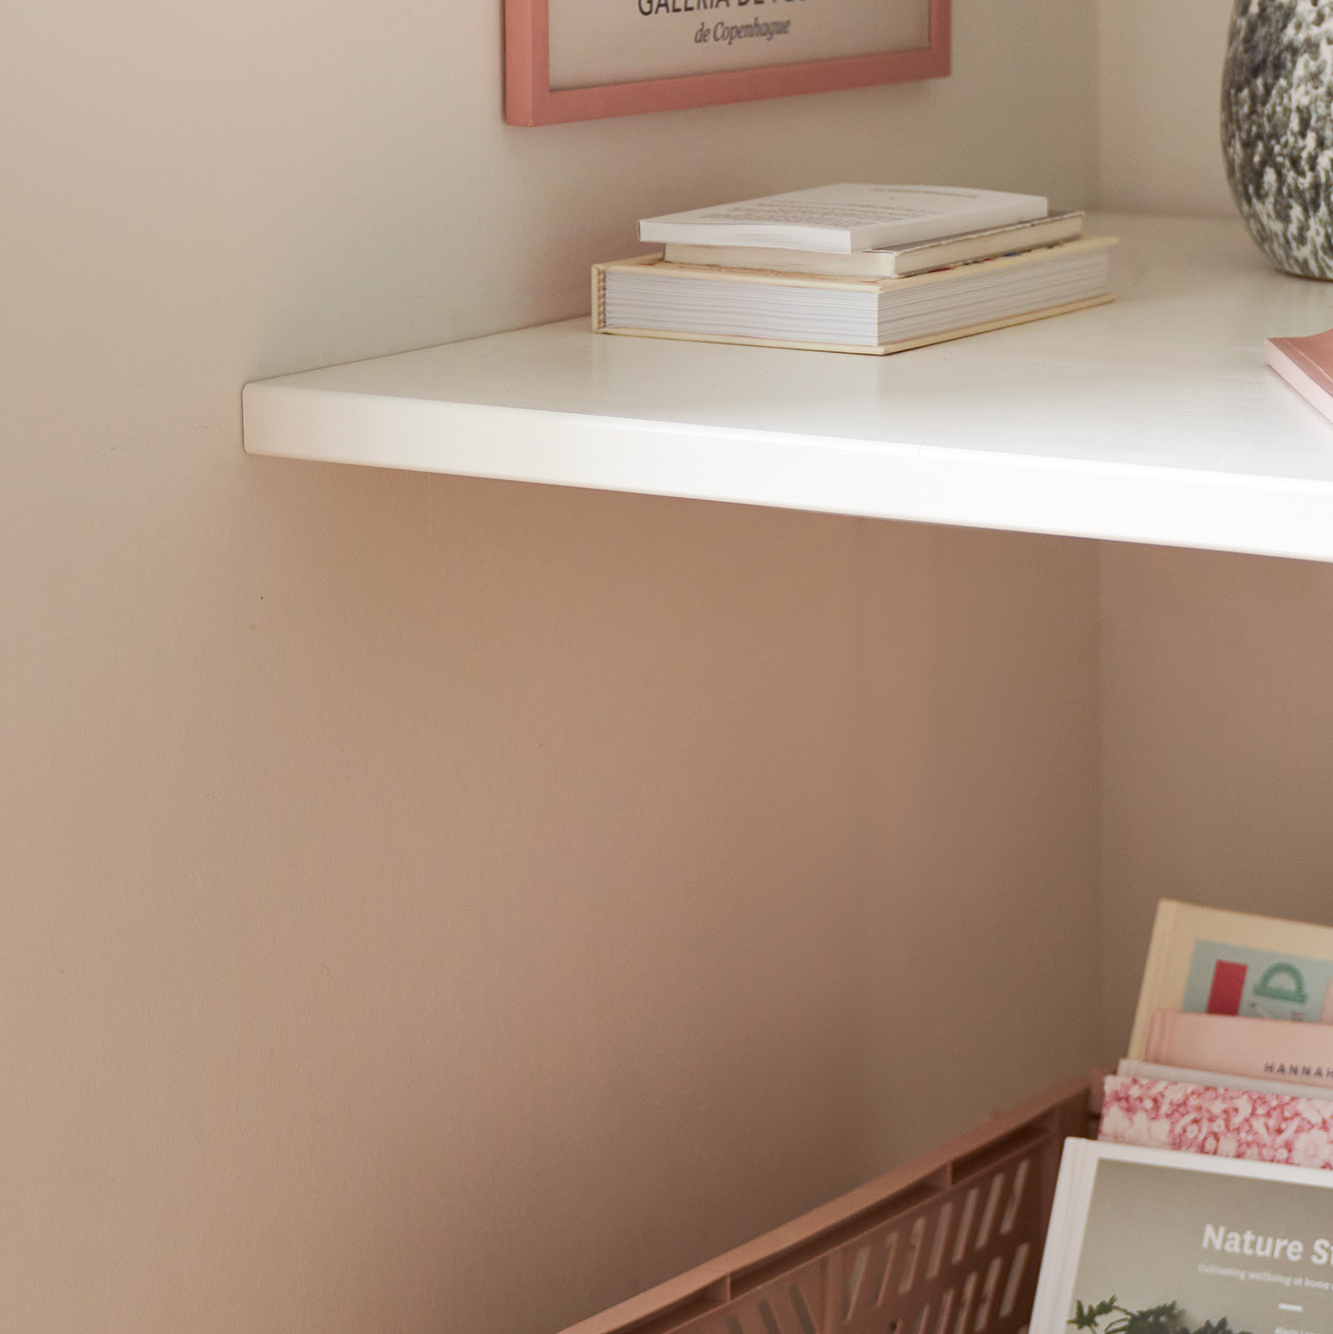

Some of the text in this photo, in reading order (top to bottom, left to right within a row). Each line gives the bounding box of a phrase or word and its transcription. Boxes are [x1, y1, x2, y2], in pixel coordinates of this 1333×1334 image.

[694, 16, 791, 45] de Copenhague
[1201, 1223, 1304, 1261] Nature
[1197, 1263, 1246, 1280] Cultivating
[1247, 1270, 1292, 1287] wellbeing
[1293, 1277, 1303, 1287] at
[1304, 1277, 1330, 1291] home
